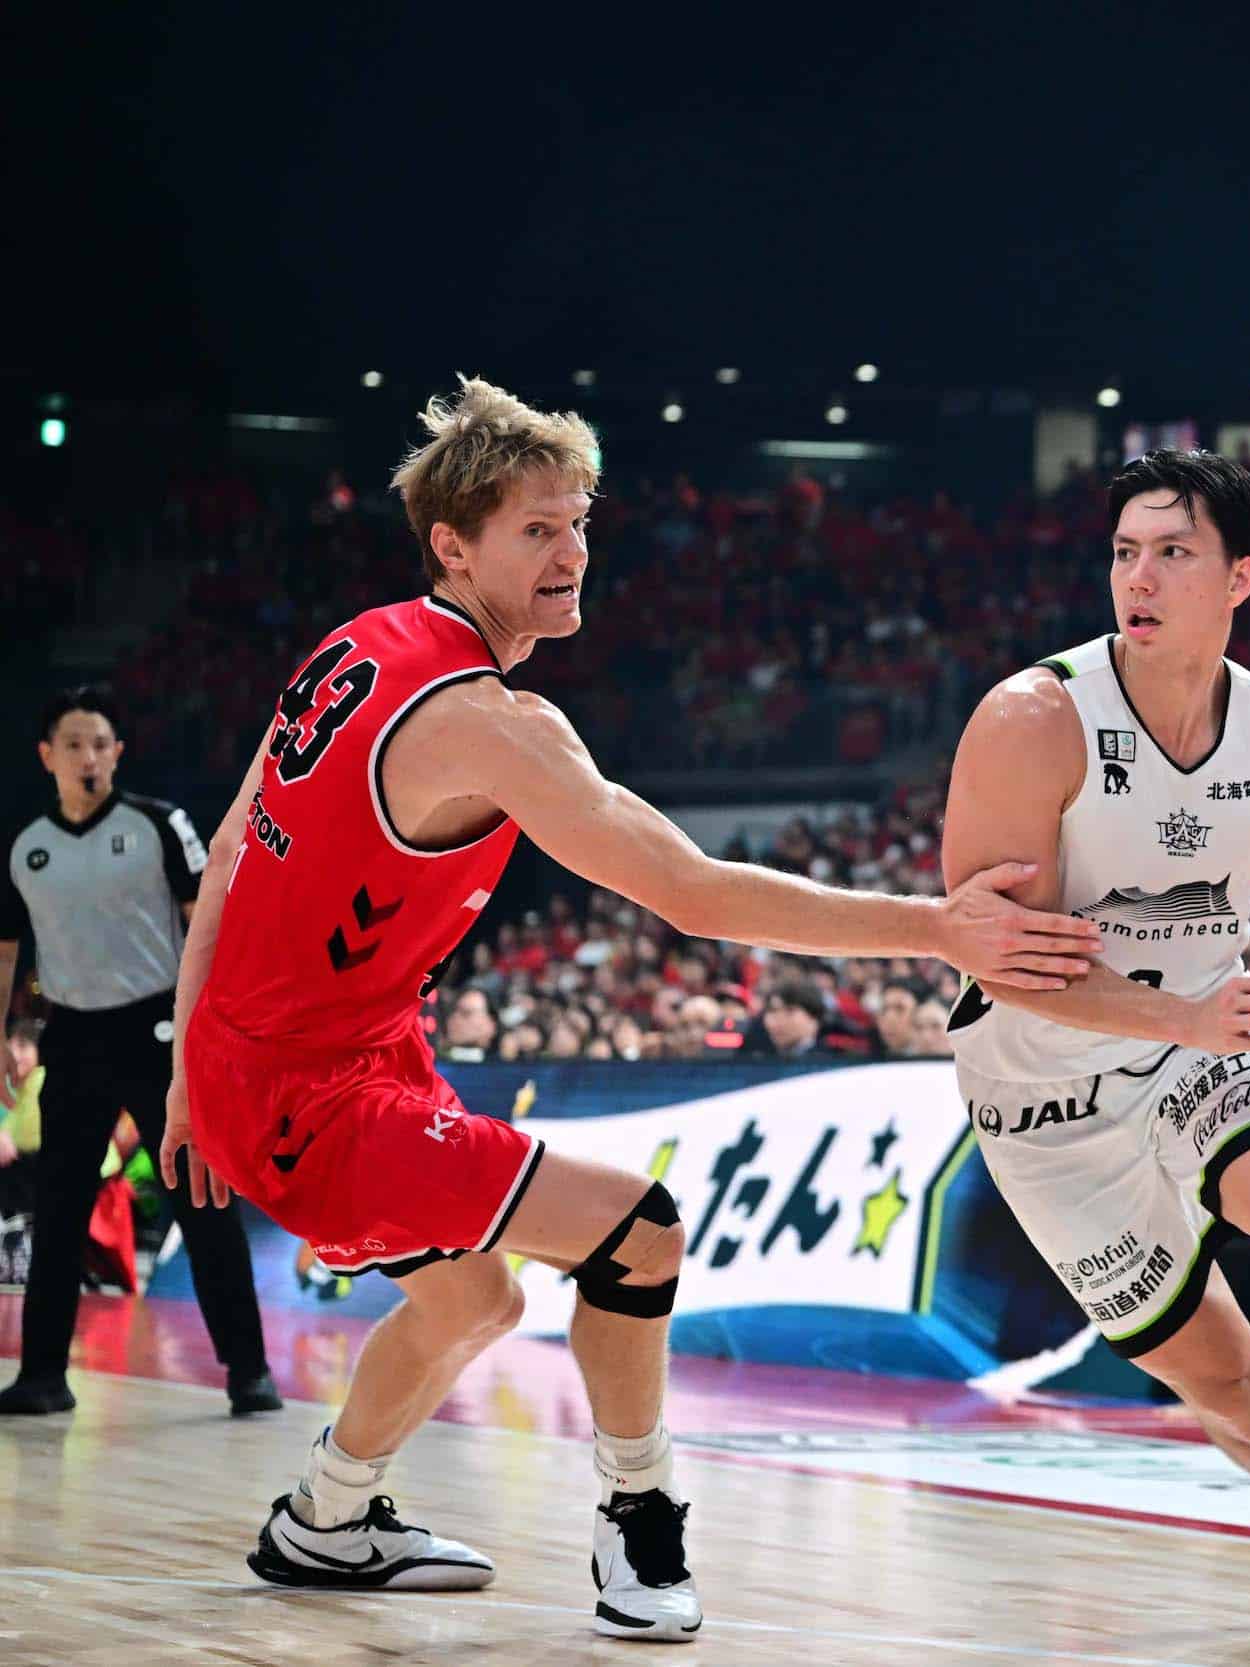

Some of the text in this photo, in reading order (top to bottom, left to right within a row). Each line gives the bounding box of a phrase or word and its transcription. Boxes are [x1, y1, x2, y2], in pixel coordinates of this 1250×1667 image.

[270, 636, 380, 786] 43
[247, 783, 294, 862] TON
[1070, 902, 1240, 941] amond head
[1009, 1098, 1097, 1134] JAL
[1077, 1230, 1139, 1277] Ohfuji
